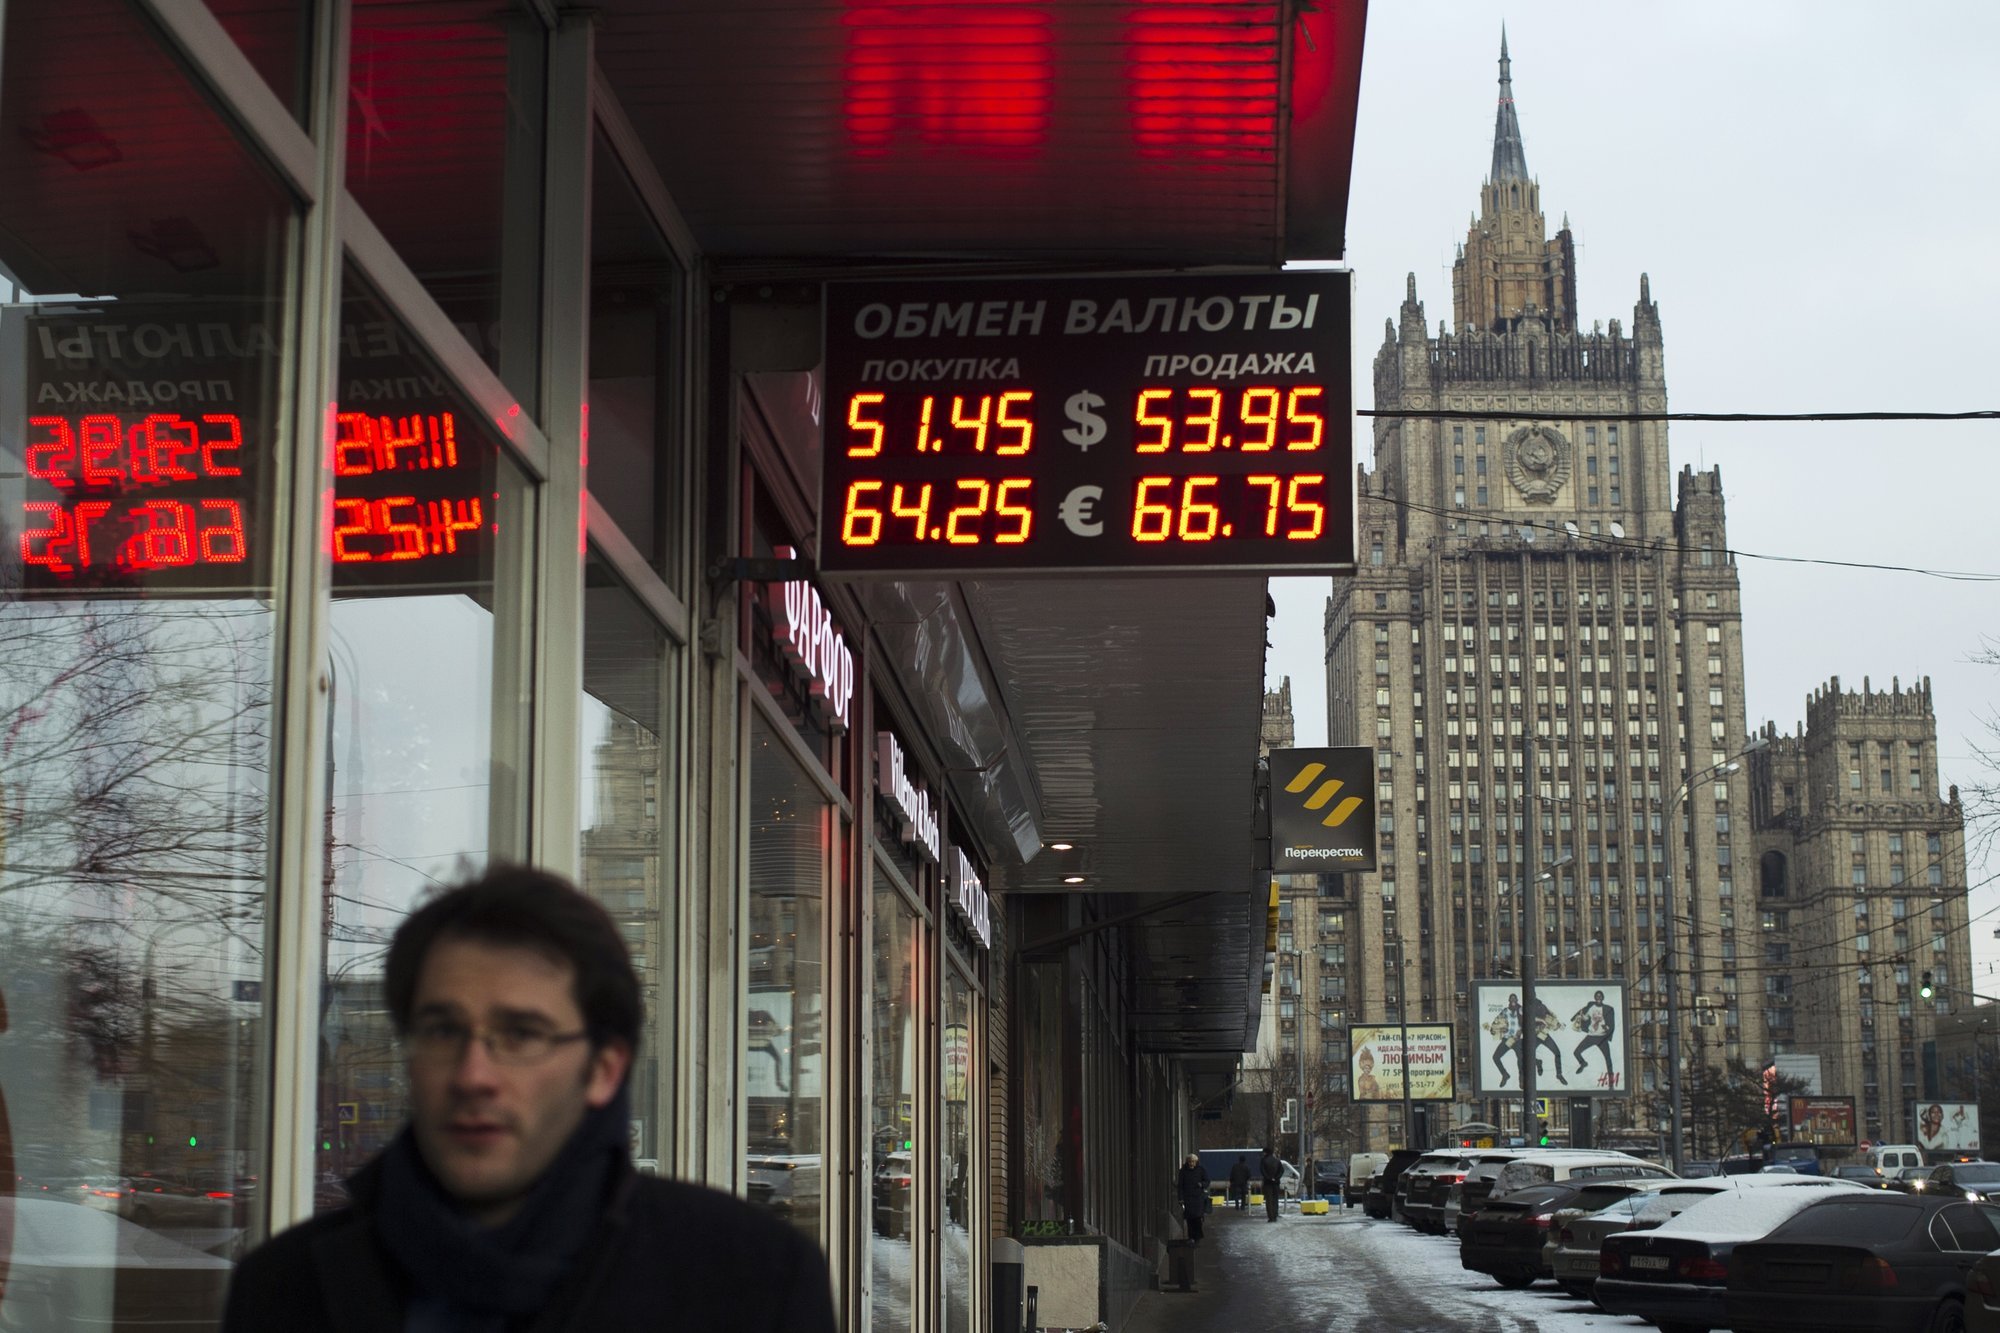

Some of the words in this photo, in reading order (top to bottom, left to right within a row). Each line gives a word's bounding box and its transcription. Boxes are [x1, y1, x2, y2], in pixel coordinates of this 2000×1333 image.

[854, 299, 1047, 339] ОБМЕН
[1063, 294, 1320, 335] ВАЛЮТЫ
[861, 357, 1021, 382] ПОКУПКА
[1144, 351, 1316, 380] ПРОДАЖА
[847, 391, 1034, 457] 51.45
[1062, 389, 1107, 453] $
[1135, 387, 1323, 453] 53.95
[841, 478, 1034, 545] 64.25
[1058, 485, 1104, 537] €
[1131, 475, 1323, 542] 66.75
[784, 546, 855, 730] ФАРФОР
[1285, 847, 1363, 860] Перекресток
[1377, 1045, 1416, 1053] ИДЕАЛЬЫЕ
[1382, 1053, 1444, 1064] ЛЮИМЫМ
